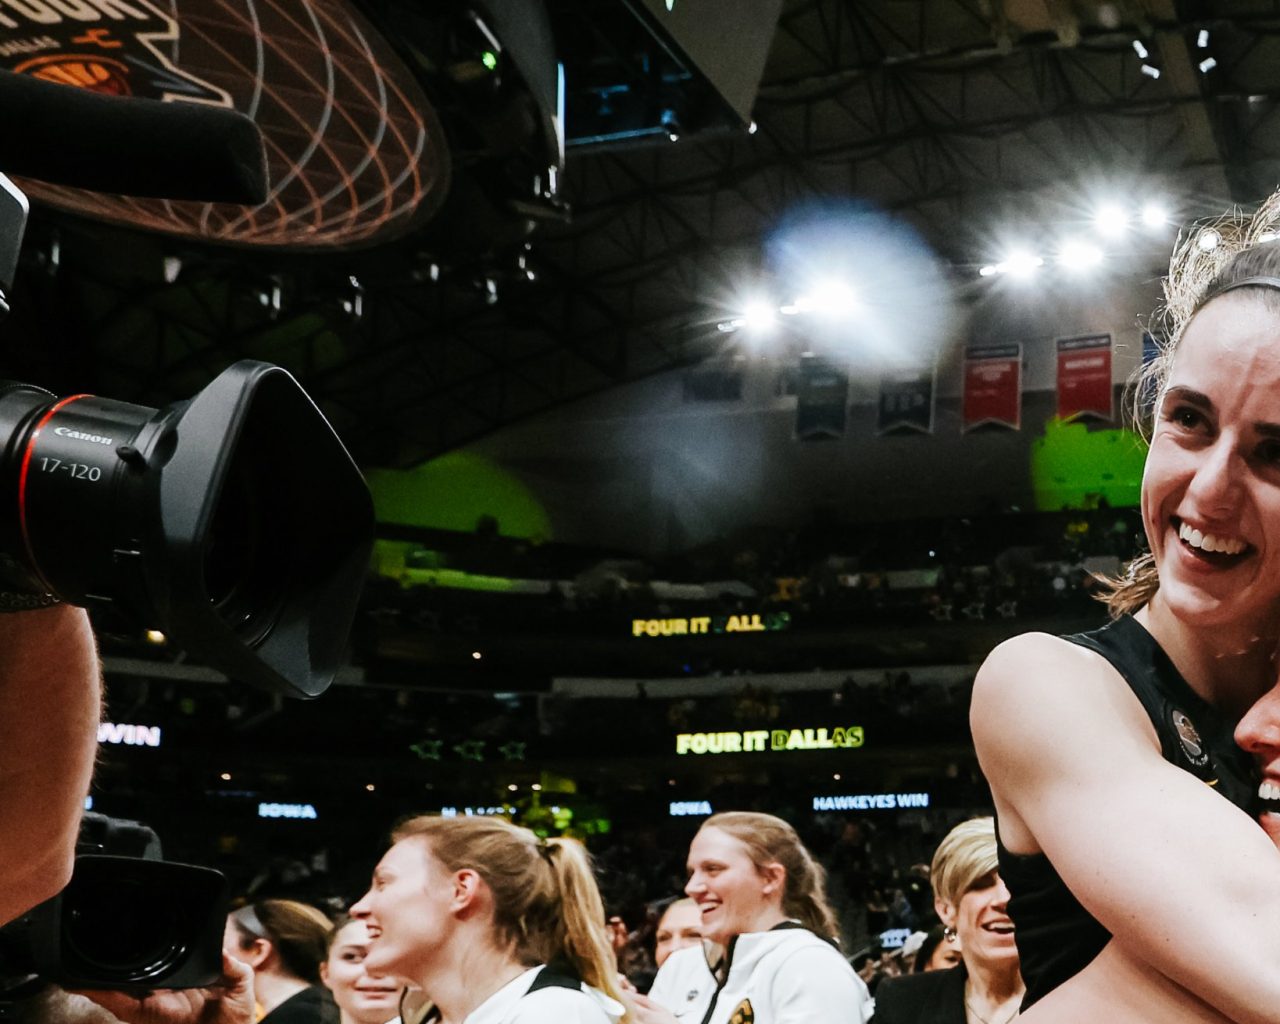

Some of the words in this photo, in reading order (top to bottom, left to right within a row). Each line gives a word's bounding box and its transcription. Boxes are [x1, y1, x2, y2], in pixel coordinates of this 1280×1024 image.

[54, 427, 113, 445] Canon
[41, 457, 101, 481] 17-120
[632, 618, 688, 636] FOUR
[689, 616, 711, 633] IT
[676, 731, 742, 754] FOUR
[742, 730, 769, 751] IT
[770, 726, 865, 750] DALLAS
[812, 795, 897, 810] HAWKEYES
[897, 793, 929, 807] WIN
